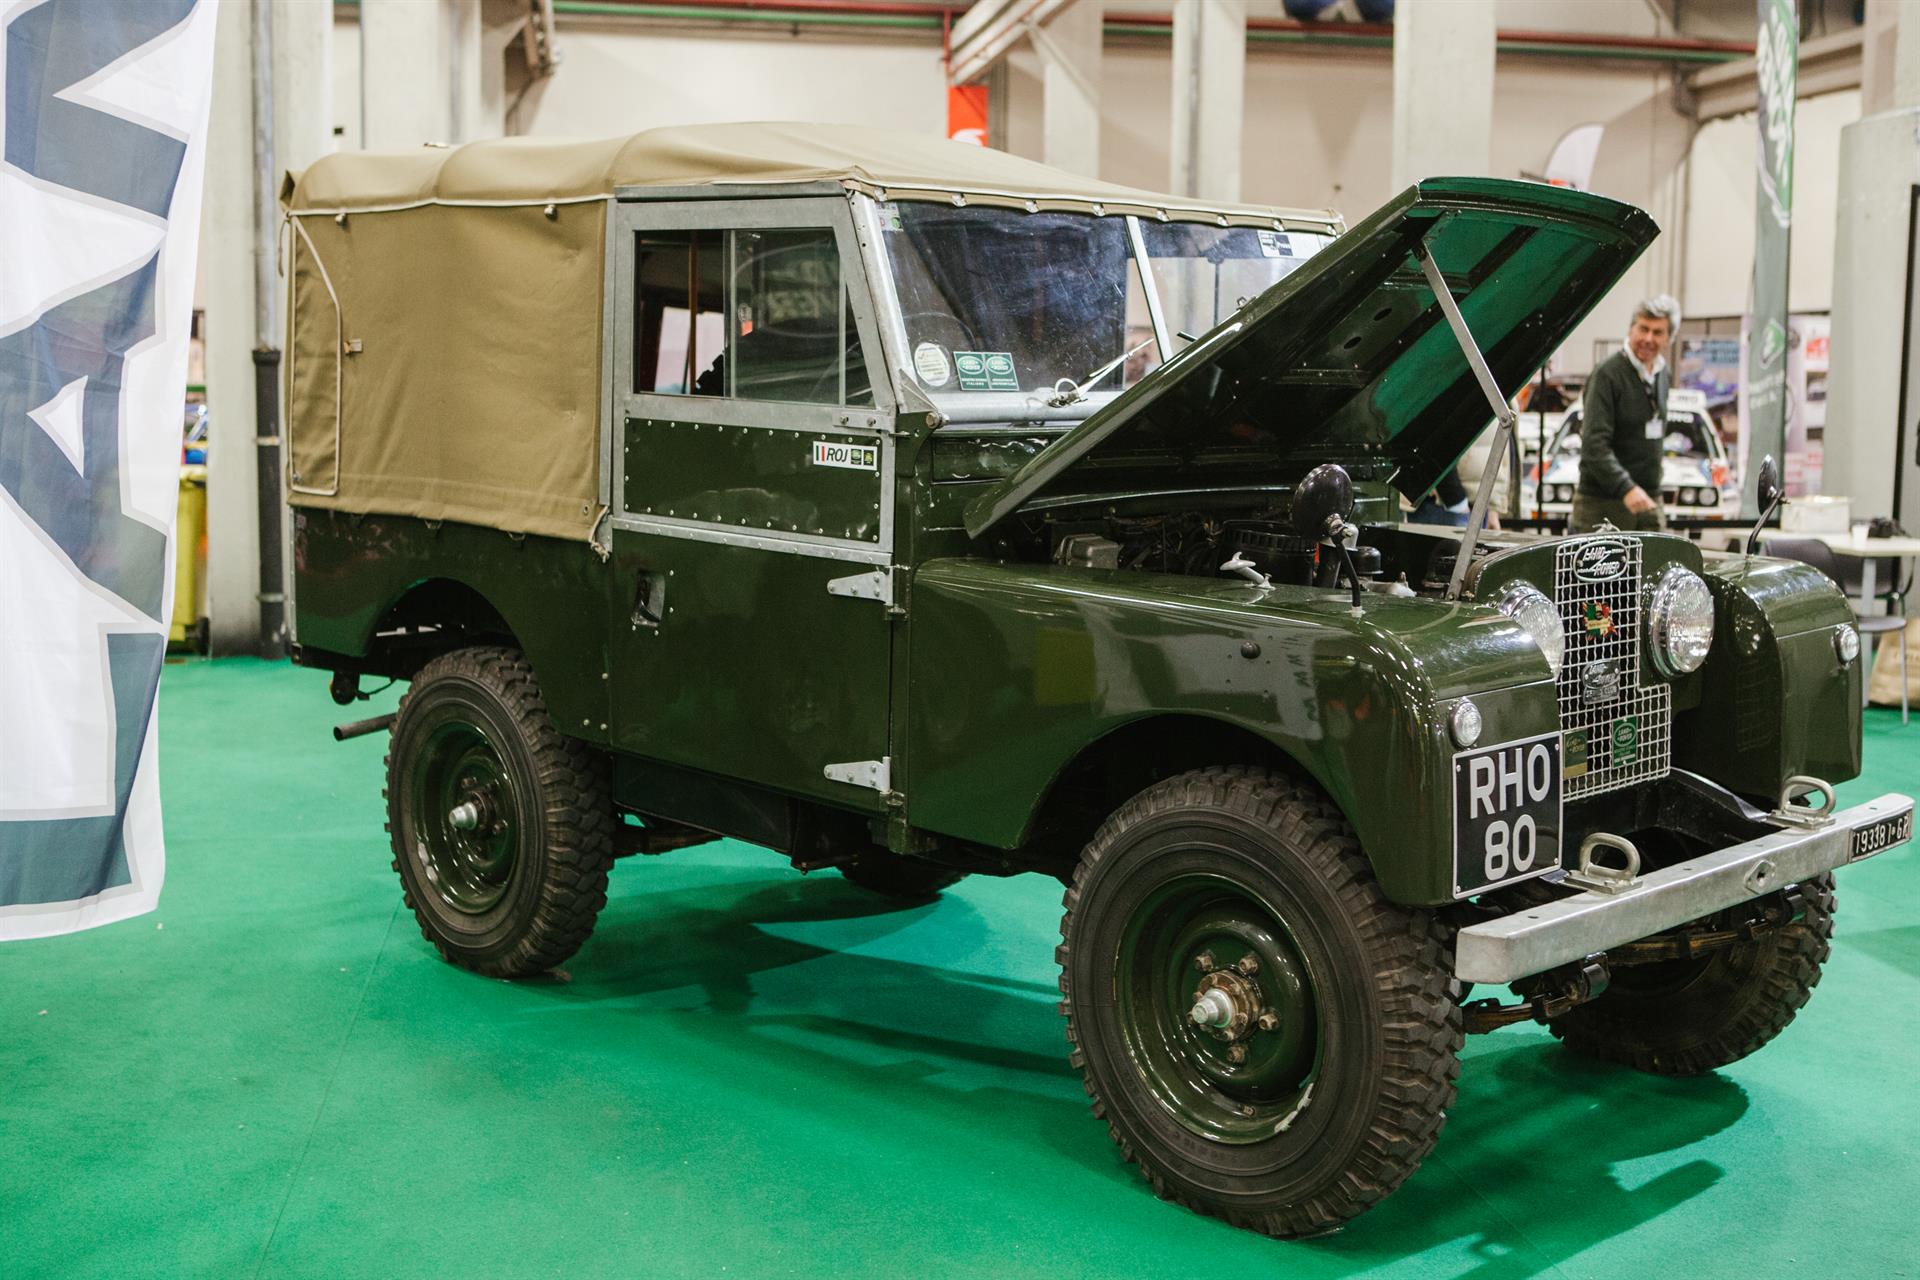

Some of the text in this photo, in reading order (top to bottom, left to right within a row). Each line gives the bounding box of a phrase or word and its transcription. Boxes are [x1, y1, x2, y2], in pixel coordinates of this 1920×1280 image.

[826, 447, 849, 463] ROJ
[1582, 546, 1606, 561] LAND
[1593, 561, 1620, 576] ROVER
[1469, 743, 1551, 819] RHO
[1484, 813, 1537, 881] 80
